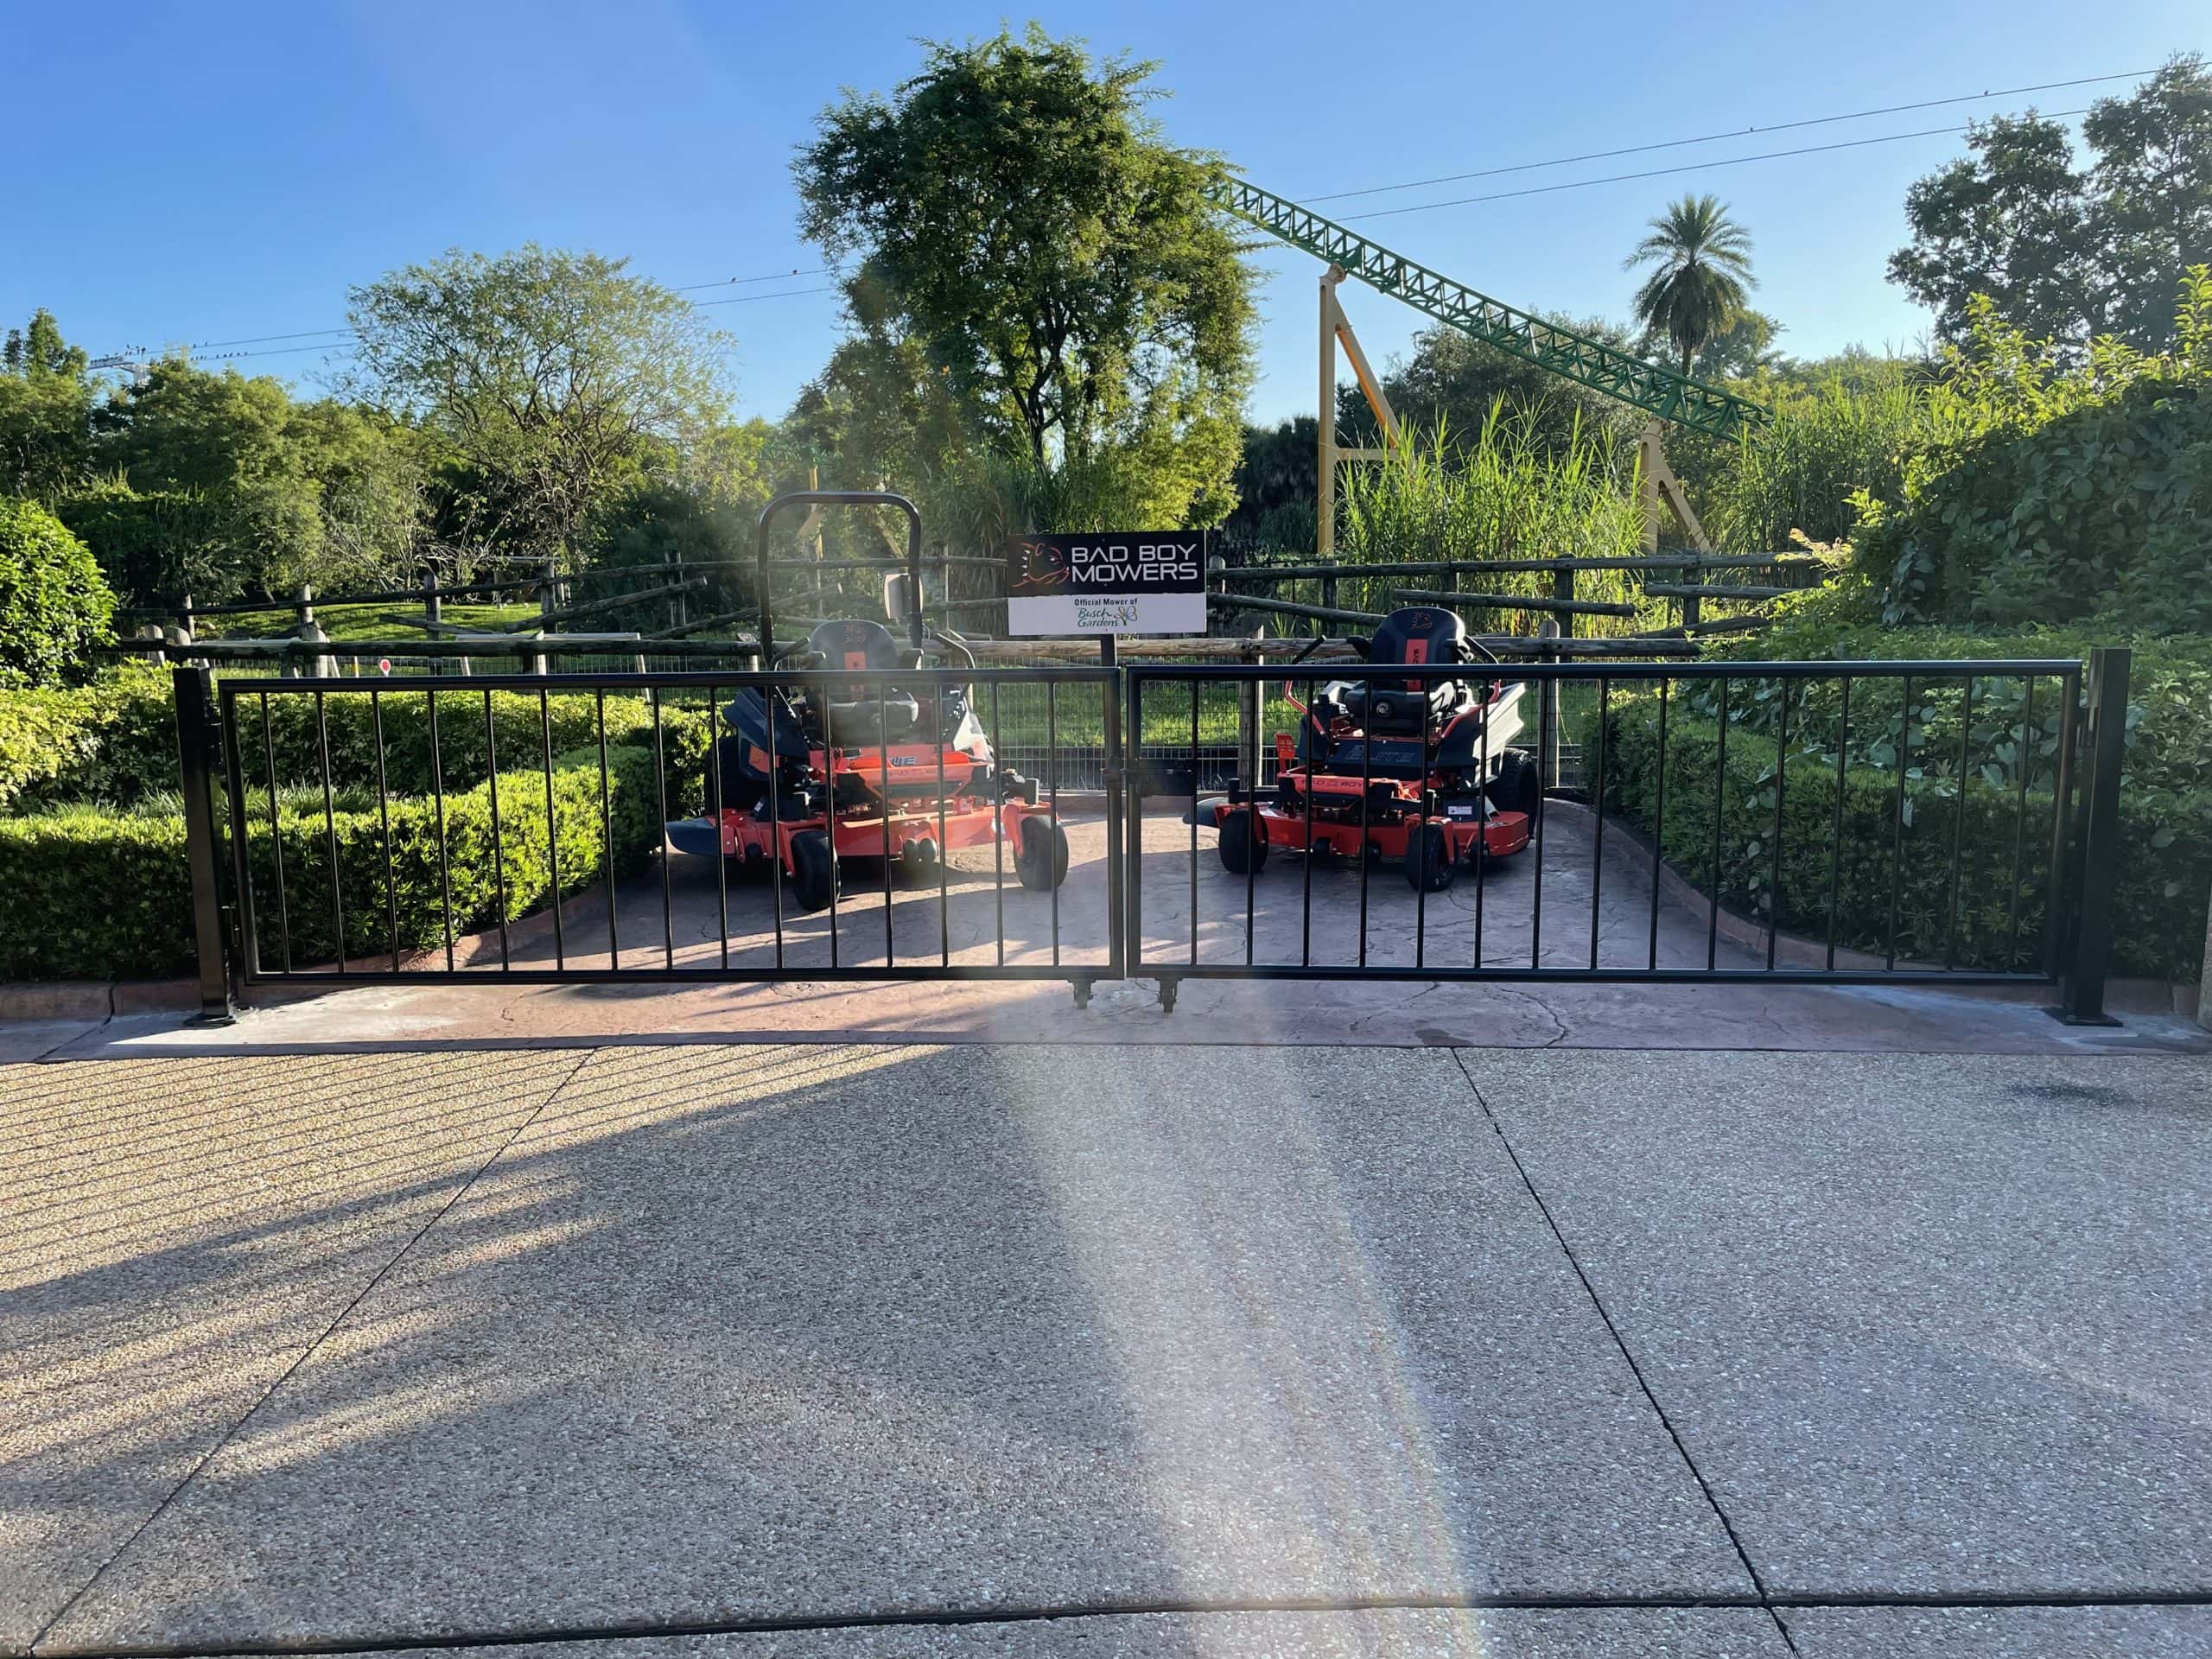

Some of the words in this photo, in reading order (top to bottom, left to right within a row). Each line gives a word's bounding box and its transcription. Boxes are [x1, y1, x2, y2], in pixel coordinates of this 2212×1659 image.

[1071, 546, 1128, 563] BAD
[1139, 543, 1197, 561] BOY
[1071, 563, 1198, 582] MOWERS
[1074, 598, 1101, 607] Official
[1103, 597, 1128, 606] Mower
[1129, 597, 1138, 606] of
[1077, 607, 1112, 619] Busch
[1077, 617, 1119, 628] Gardens
